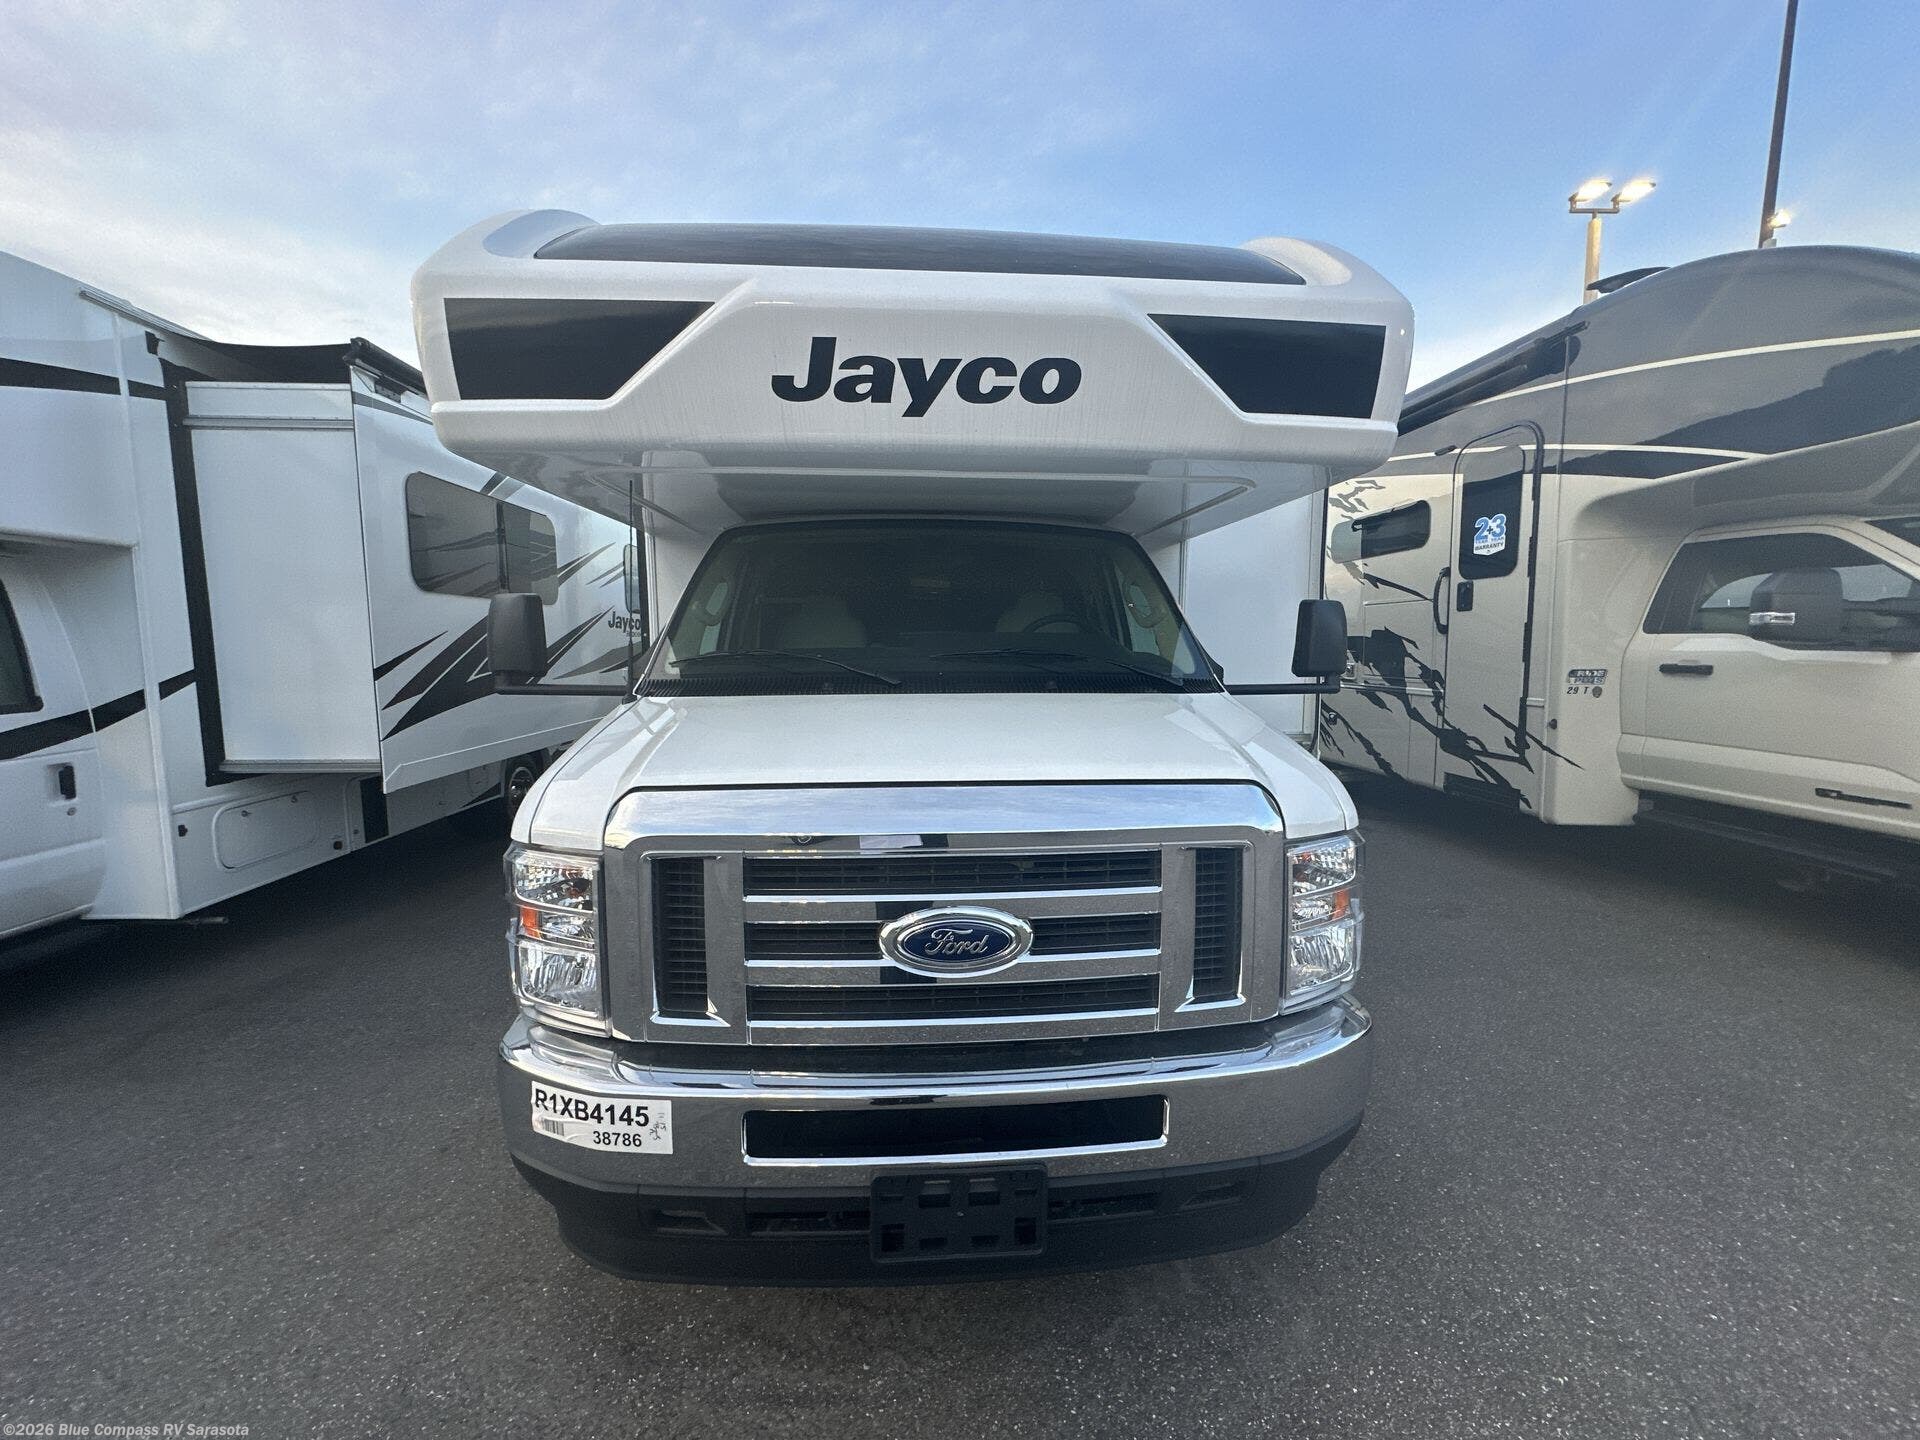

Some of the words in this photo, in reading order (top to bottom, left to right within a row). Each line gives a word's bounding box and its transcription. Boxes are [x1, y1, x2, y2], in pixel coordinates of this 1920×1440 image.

[771, 336, 1082, 418] Jayco
[608, 611, 641, 634] Jayco
[925, 928, 989, 956] Ford
[535, 1088, 650, 1127] R1XB4145
[593, 1130, 642, 1148] 38786
